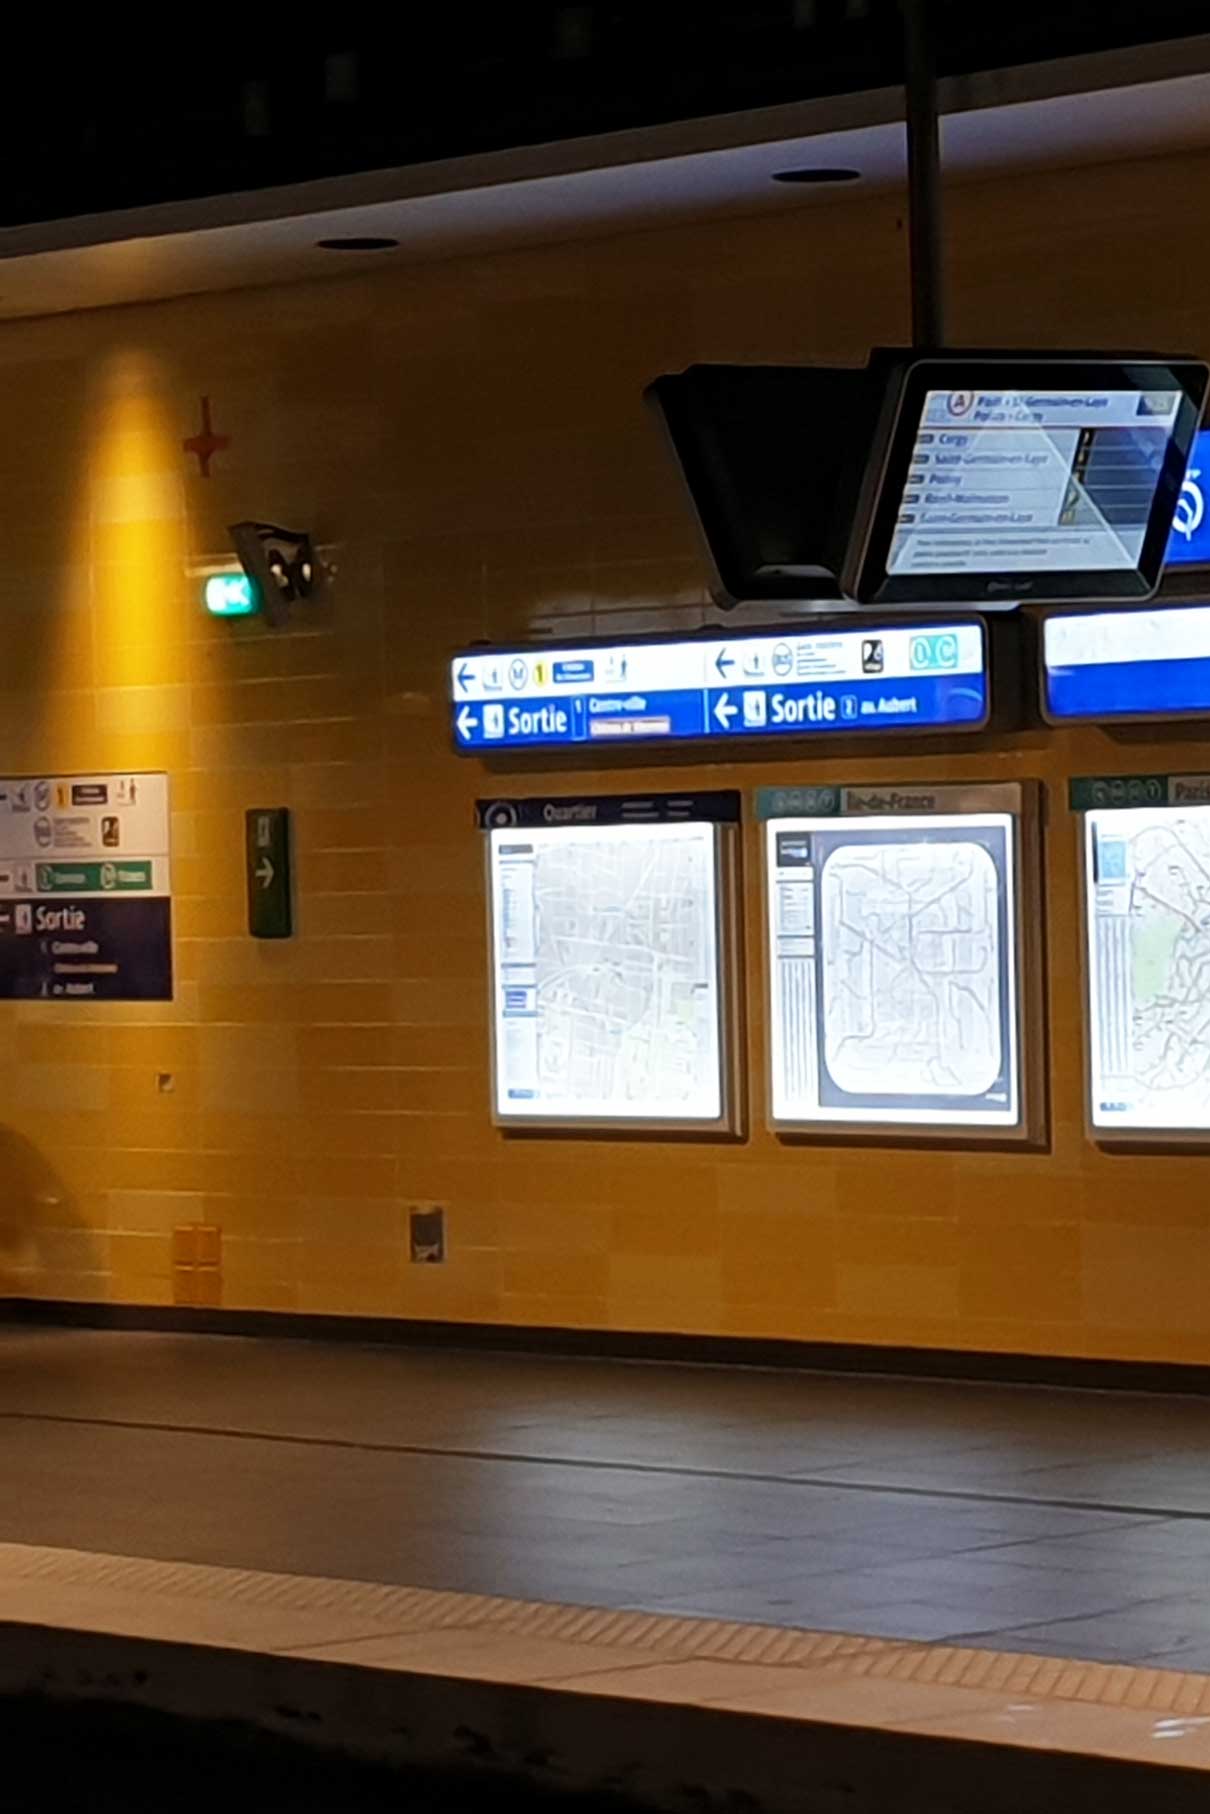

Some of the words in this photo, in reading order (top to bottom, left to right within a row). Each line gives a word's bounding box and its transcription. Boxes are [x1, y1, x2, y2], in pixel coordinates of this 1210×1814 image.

[508, 704, 568, 736] Sortie
[771, 690, 837, 723] Sortie
[36, 905, 86, 932] Sortie
